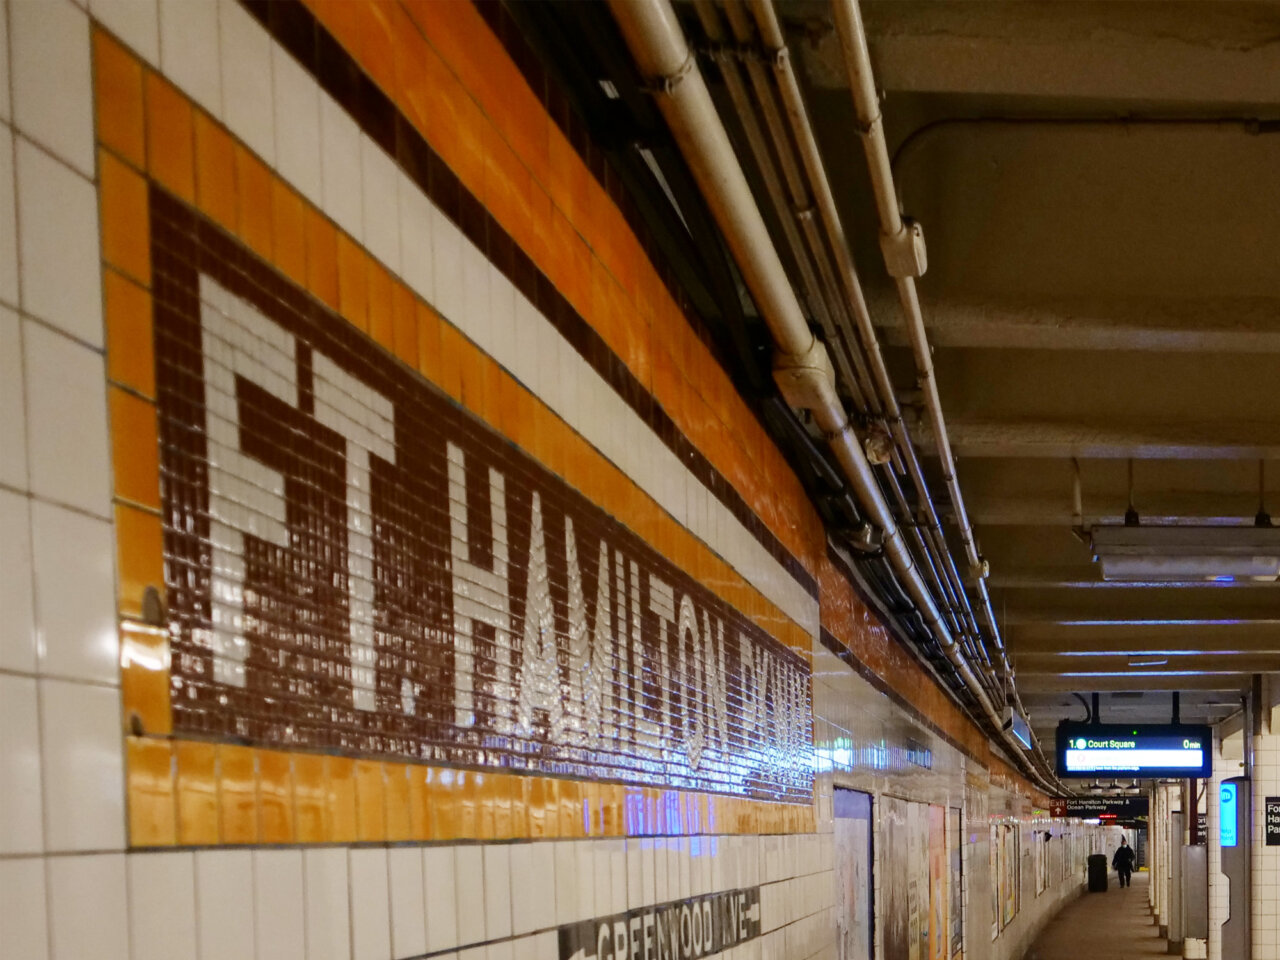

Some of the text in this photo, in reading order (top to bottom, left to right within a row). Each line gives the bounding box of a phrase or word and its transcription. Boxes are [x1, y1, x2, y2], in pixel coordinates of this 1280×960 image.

[199, 272, 416, 716] FT.
[447, 440, 728, 770] HAMILTON
[1087, 739, 1109, 749] Court
[1109, 739, 1136, 750] Square
[1050, 799, 1066, 807] Exit
[721, 893, 748, 946] AVE
